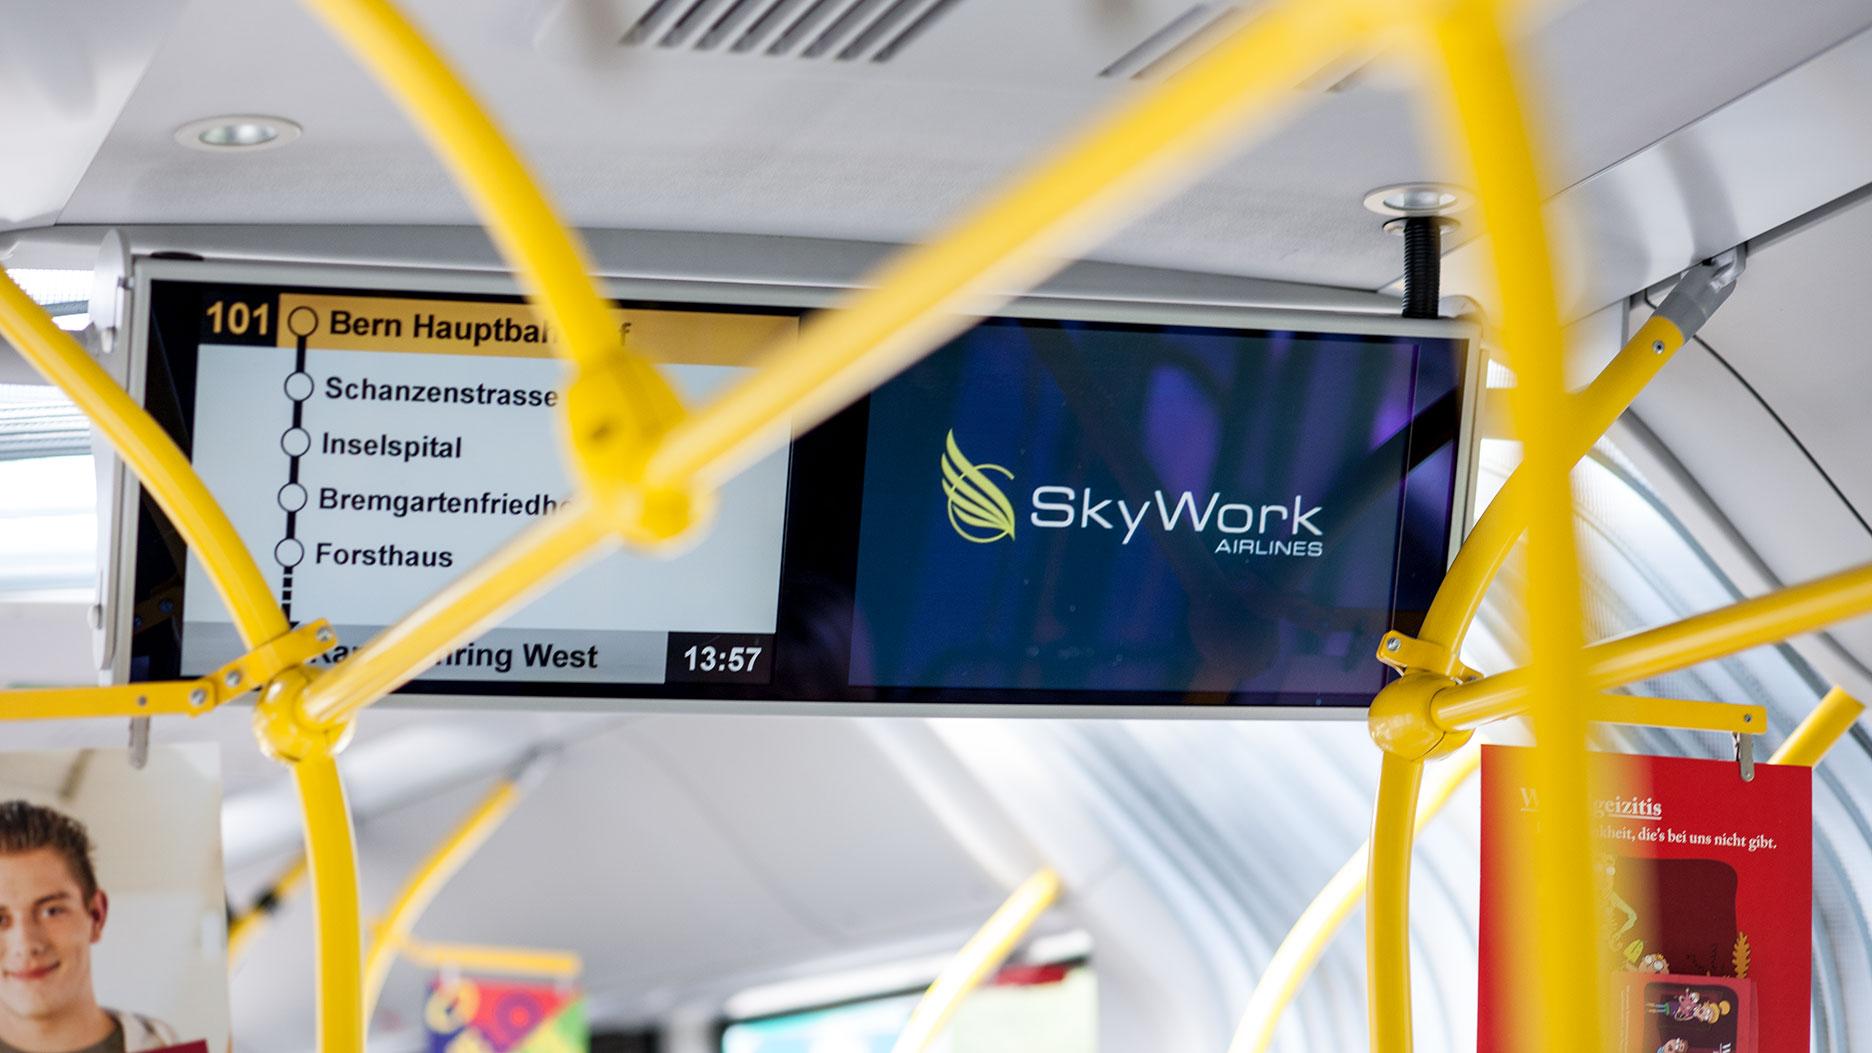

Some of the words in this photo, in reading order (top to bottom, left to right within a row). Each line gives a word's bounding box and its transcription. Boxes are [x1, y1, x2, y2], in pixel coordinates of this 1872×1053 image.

[206, 301, 269, 336] 101
[330, 310, 402, 337] Bern
[413, 313, 632, 347] Hauptbahf
[325, 376, 559, 408] Schanzenstrasse
[322, 432, 462, 462] Inselspital
[1030, 485, 1323, 544] SkyWork
[316, 542, 453, 568] Forsthaus
[1214, 538, 1323, 557] AIRLINES
[523, 643, 598, 668] West
[684, 645, 762, 672] 13:57
[1667, 828, 1687, 844] bei
[1689, 833, 1712, 845] uns
[1714, 832, 1746, 847] nicht
[1748, 834, 1777, 852] gibt.
